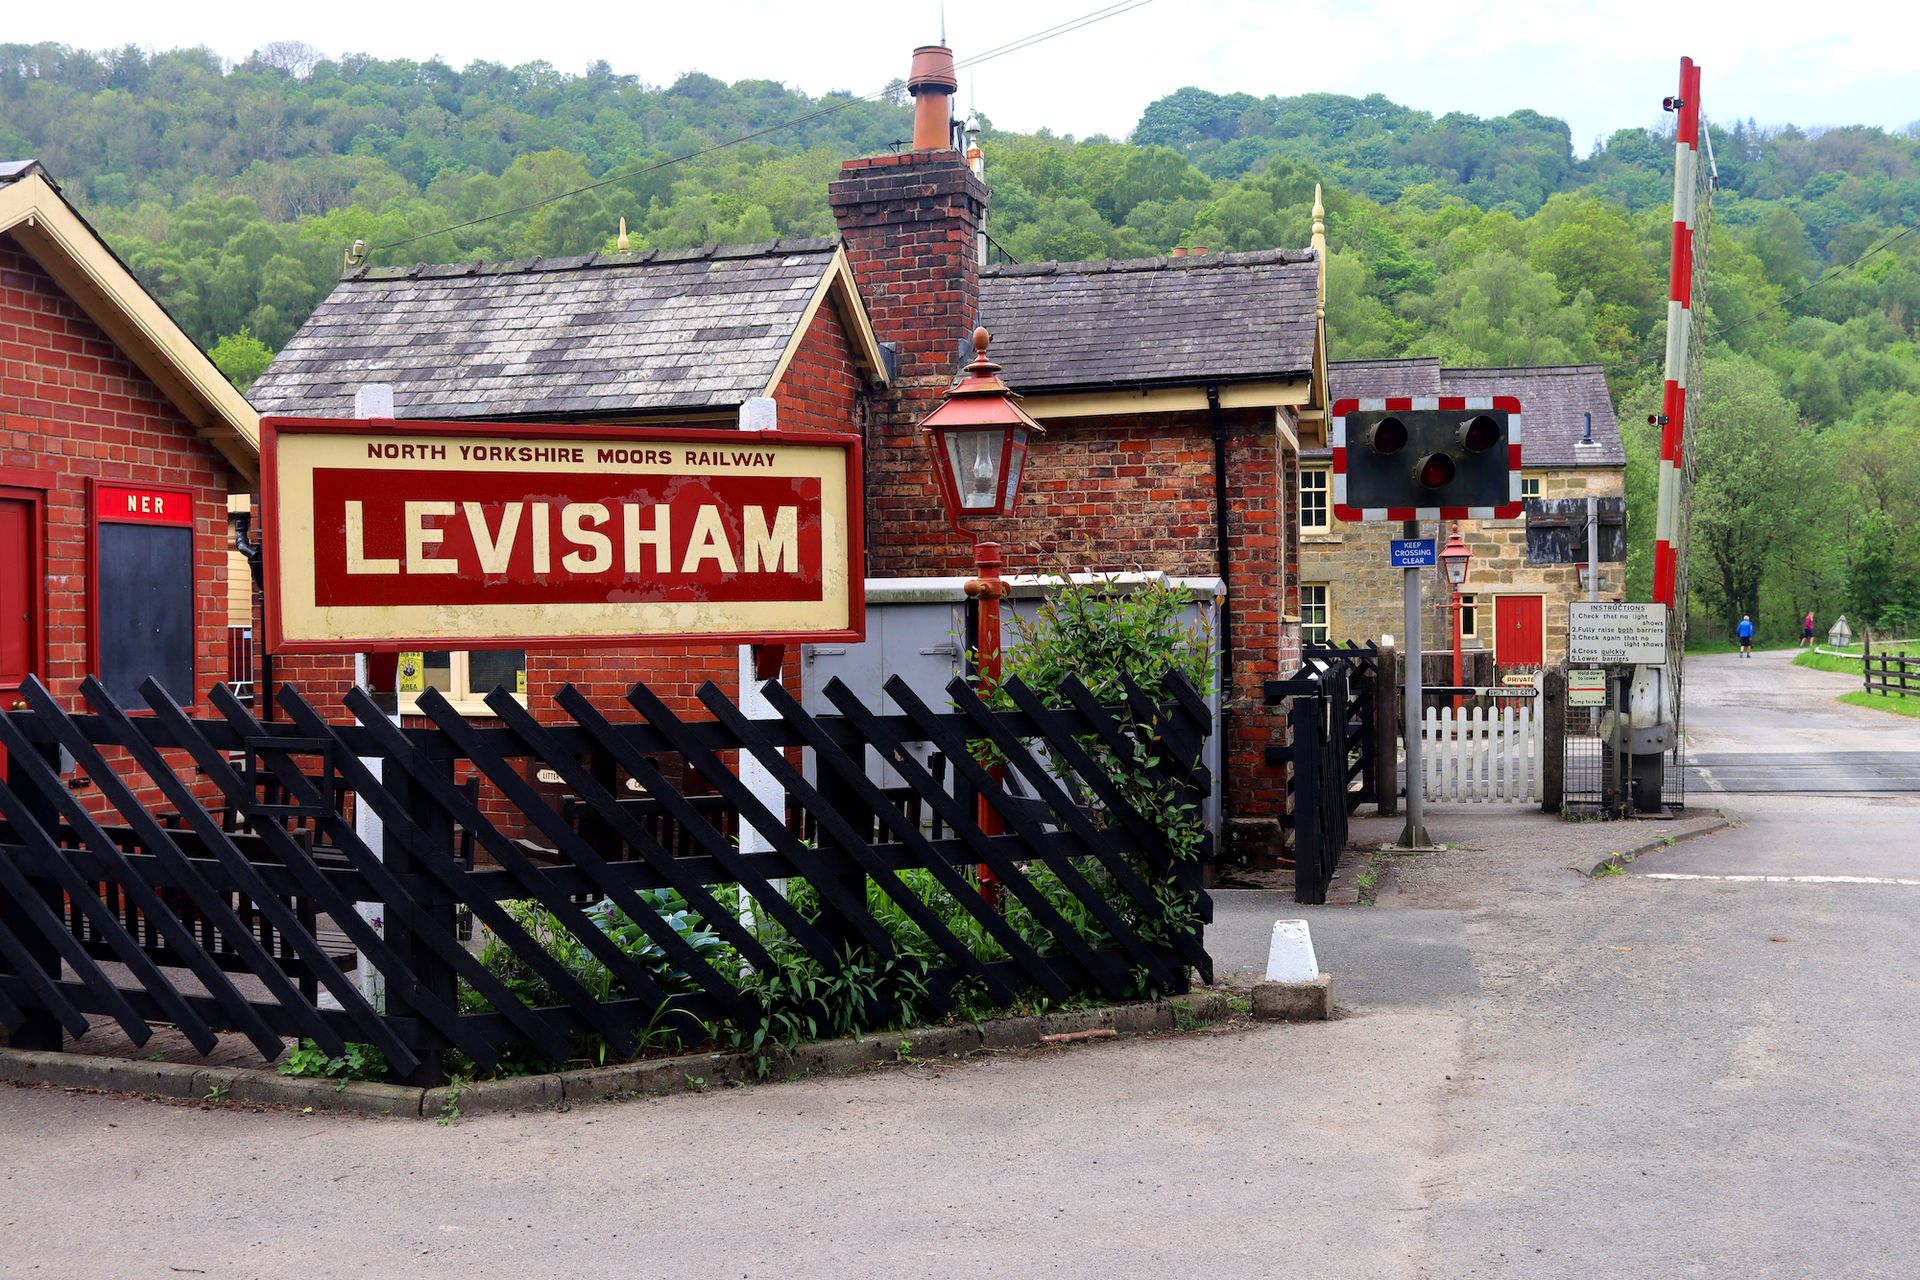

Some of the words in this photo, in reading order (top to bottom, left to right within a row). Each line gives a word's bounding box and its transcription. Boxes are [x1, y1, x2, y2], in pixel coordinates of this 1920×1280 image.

[367, 443, 446, 460] NORTH
[459, 445, 585, 463] YORKSHIRE
[597, 448, 672, 465] MOORS
[685, 451, 776, 467] RAILWAY
[127, 494, 164, 514] NER
[344, 499, 799, 575] LEVISHAM
[1403, 541, 1422, 549] KEEP
[1394, 549, 1432, 557] CROSSING
[1402, 557, 1425, 565] CLEAR
